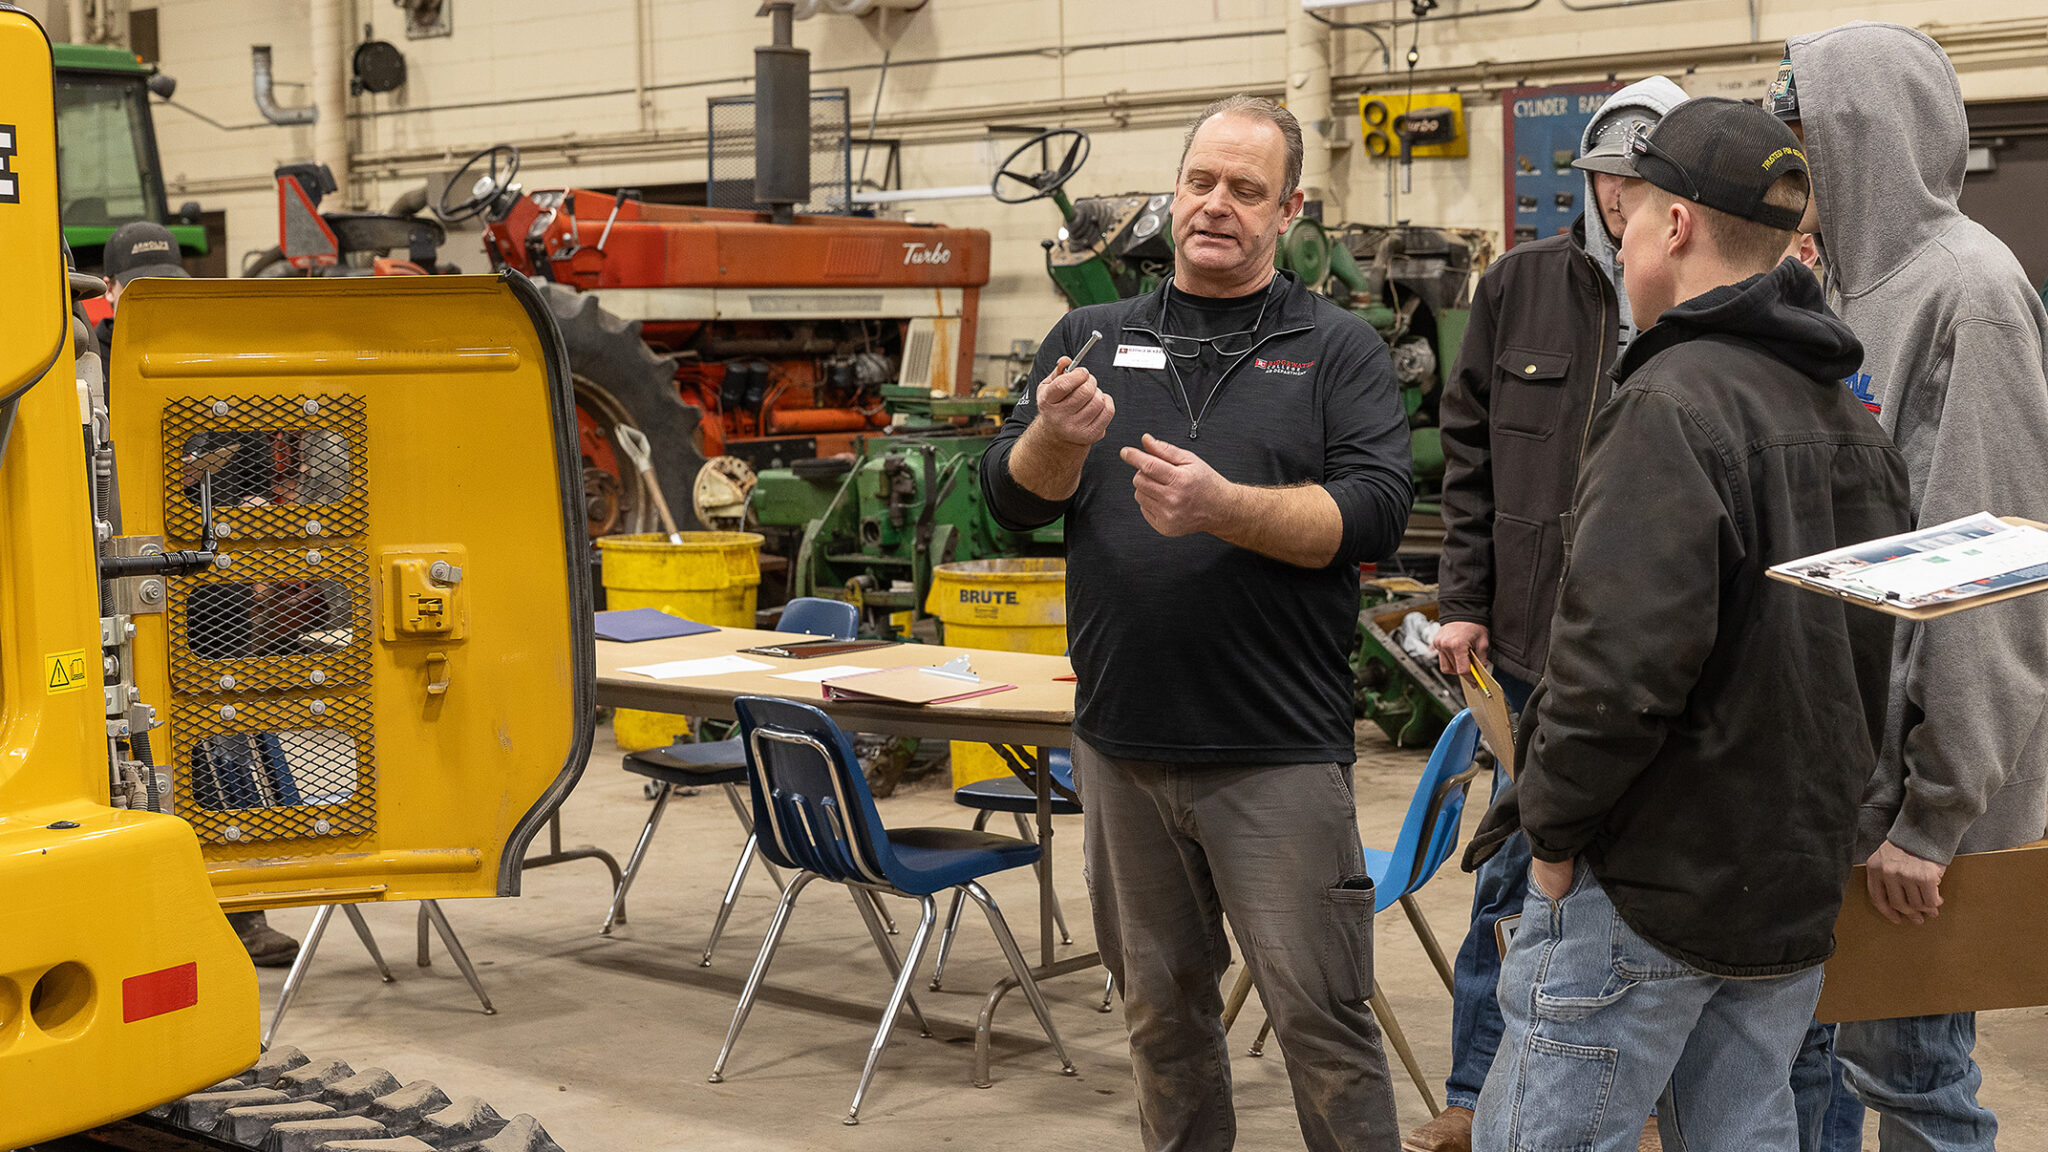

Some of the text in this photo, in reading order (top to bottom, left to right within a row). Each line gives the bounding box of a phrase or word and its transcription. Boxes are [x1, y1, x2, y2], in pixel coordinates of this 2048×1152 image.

[1513, 97, 1568, 118] CYLINDER
[1761, 149, 1783, 171] TRUSTED
[902, 242, 952, 266] Turbo
[959, 589, 1019, 605] BRUTE
